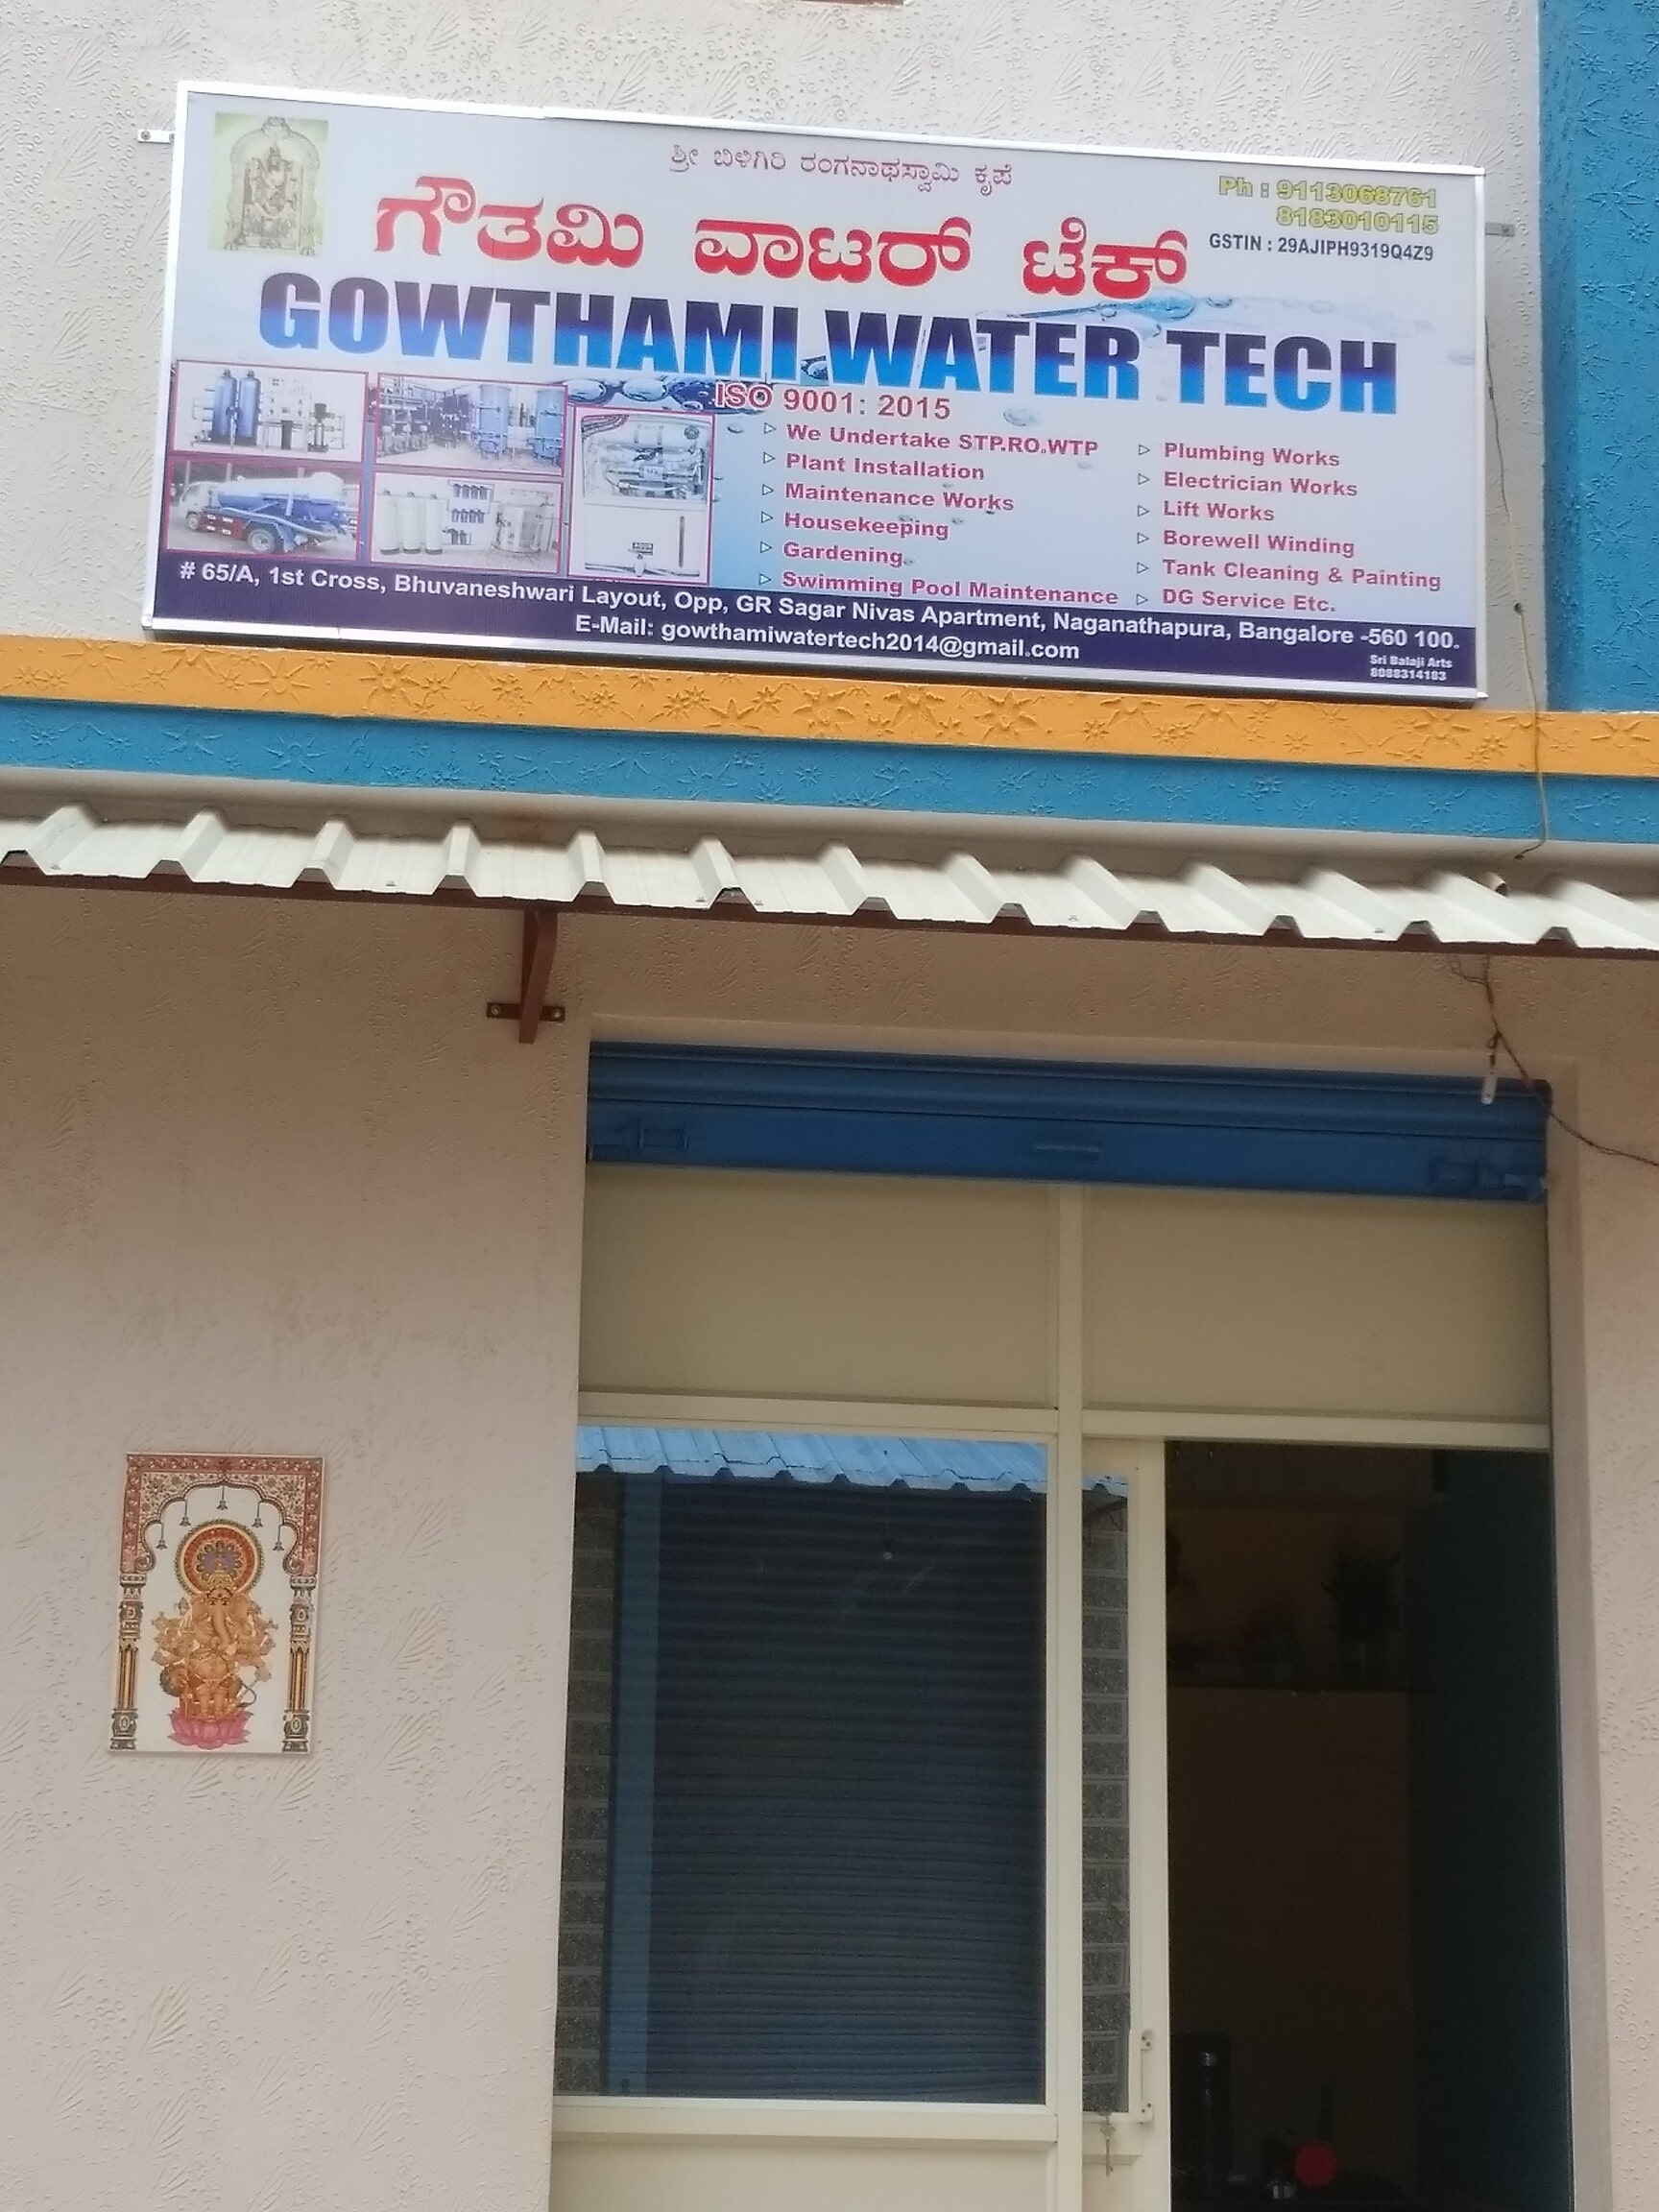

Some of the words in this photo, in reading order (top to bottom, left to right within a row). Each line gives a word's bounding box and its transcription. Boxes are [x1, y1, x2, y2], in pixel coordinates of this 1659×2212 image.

[1219, 176, 1253, 198] Ph
[1277, 180, 1436, 208] 9113068761
[1276, 205, 1439, 235] 8183010115
[373, 175, 645, 269] ಗೌತಮಿ
[693, 214, 972, 289] ವಾಟರ್
[1022, 216, 1189, 300] ಟೆಕ್
[1209, 232, 1262, 252] GSTIN
[1278, 237, 1434, 261] 29AJIPH9319Q4Z9
[258, 271, 798, 382] GOWTHAMI
[824, 308, 1141, 401] WATER
[1166, 328, 1397, 415] TECH
[715, 382, 773, 410] ISO
[782, 388, 866, 416] 9001:
[878, 394, 951, 421] 2015
[786, 423, 822, 442] We
[830, 426, 950, 450] Undertake
[959, 433, 1099, 456] STP.RO.WTP
[785, 452, 846, 473] Plant
[854, 457, 985, 481] Installation
[1164, 442, 1264, 467] Plumbing
[1272, 446, 1340, 468] Works
[784, 482, 936, 507] Maintenance
[943, 491, 1015, 511] Works
[1164, 471, 1283, 494] Electrician
[1289, 477, 1358, 497] Works
[1164, 500, 1200, 518] Lift
[1207, 502, 1275, 522] Works
[783, 512, 950, 541] Housekeeping
[782, 541, 903, 568] Gardening
[1163, 529, 1260, 550] Borewell
[1267, 535, 1356, 559] Winding
[781, 571, 903, 597] Swimming
[911, 578, 960, 597] Pool
[969, 581, 1118, 606] Maintenance
[1163, 558, 1215, 577] Tank
[1223, 562, 1319, 587] Cleaning
[1329, 566, 1343, 584] &
[1352, 568, 1441, 592] Painting
[180, 562, 195, 579] #
[202, 562, 260, 587] 65/A,
[269, 567, 303, 586] 1st
[311, 569, 387, 595] Cross,
[394, 573, 574, 603] Bhuvaneshwari
[582, 586, 666, 611] Layout,
[674, 590, 729, 615] Opp,
[736, 594, 773, 614] GR
[779, 597, 846, 621] Sagar
[853, 601, 915, 623] Nivas
[921, 605, 1046, 633] Apartment,
[1054, 613, 1231, 641] Naganathapura,
[1238, 621, 1355, 645] Bangalore
[1360, 628, 1407, 647] -560
[1414, 630, 1460, 650] 100.
[1162, 588, 1193, 606] DG
[1202, 589, 1286, 611] Service
[1293, 595, 1336, 613] Etc.
[576, 614, 654, 637] E-Mail:
[661, 620, 1080, 660] gowthamiwatertech2014@gmail.com
[1370, 654, 1386, 664] Sri
[1389, 656, 1425, 668] Balaji
[1427, 658, 1453, 668] Arts
